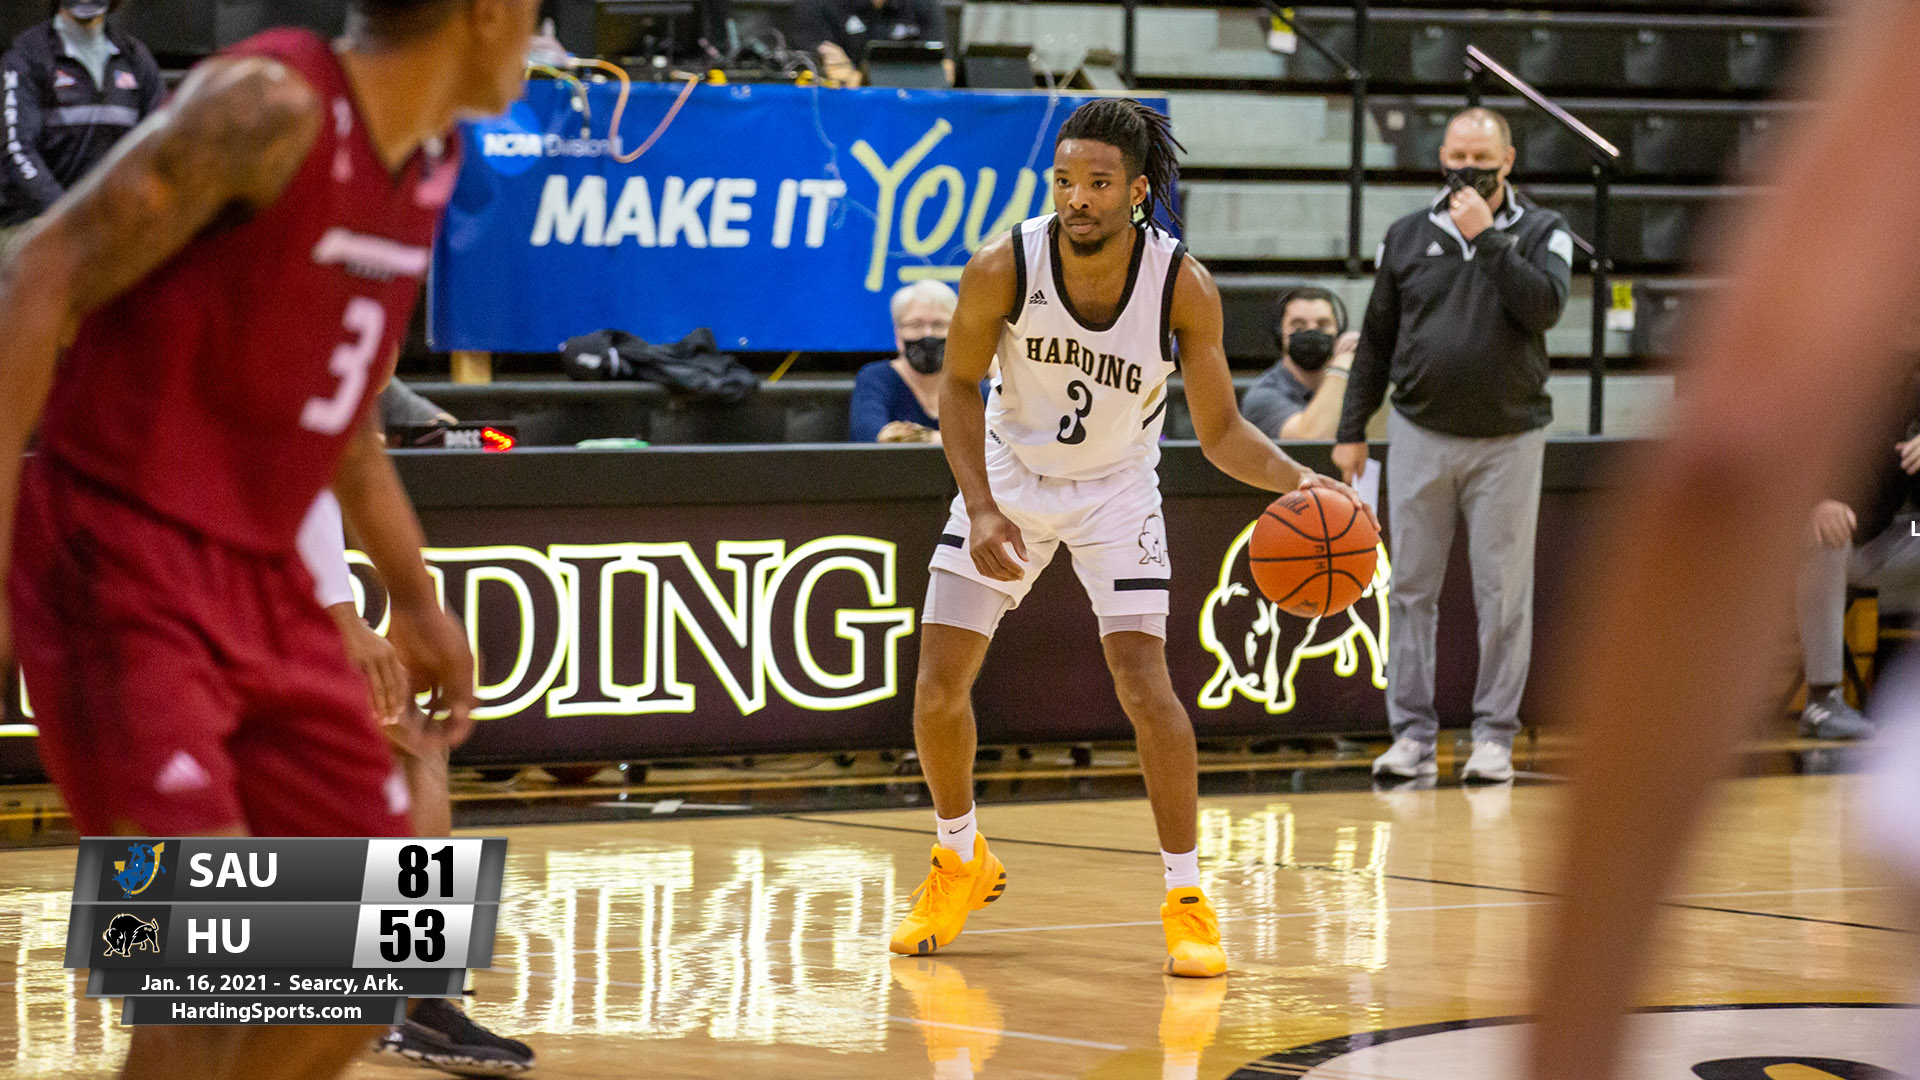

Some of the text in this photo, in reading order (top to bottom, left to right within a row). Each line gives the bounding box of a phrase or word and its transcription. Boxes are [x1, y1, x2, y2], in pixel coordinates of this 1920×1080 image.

[532, 176, 755, 247] MAKE
[773, 179, 847, 247] IT
[301, 298, 386, 436] 3
[1026, 337, 1142, 395] HARDING
[1056, 379, 1093, 445] 3
